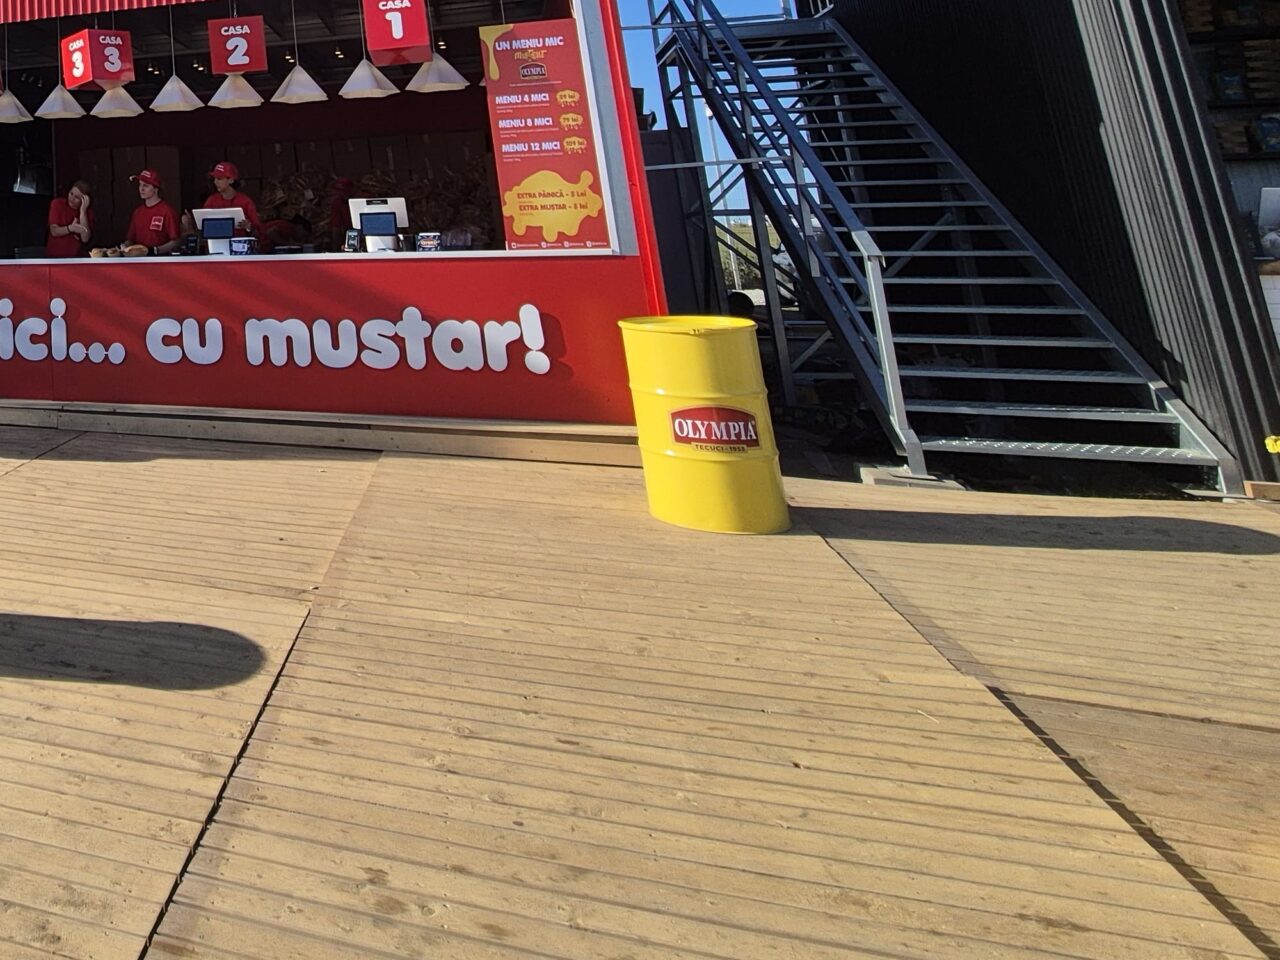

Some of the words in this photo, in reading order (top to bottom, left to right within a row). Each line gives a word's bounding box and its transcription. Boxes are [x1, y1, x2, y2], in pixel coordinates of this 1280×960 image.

[220, 24, 251, 36] CASA
[385, 11, 404, 40] 1
[68, 38, 84, 52] CASA
[99, 35, 123, 46] CASA
[495, 41, 511, 51] UN
[512, 39, 543, 50] MENIU
[545, 36, 565, 46] MIC
[225, 36, 250, 66] 2
[72, 50, 85, 78] 3
[103, 46, 122, 73] 3
[495, 94, 522, 105] MENIU
[523, 93, 530, 102] 4
[531, 93, 550, 102] MICI
[498, 118, 525, 128] MENIU
[526, 117, 534, 127] 8
[534, 117, 553, 127] MICI
[502, 142, 528, 153] MENIU
[530, 141, 540, 151] 12
[541, 141, 561, 151] MICI
[517, 192, 537, 200] EXTRA
[519, 204, 539, 212] EXTRA
[145, 318, 223, 365] cu
[245, 303, 551, 375] mustar!
[674, 419, 757, 440] OLYMPIA
[695, 444, 724, 452] TECUCI
